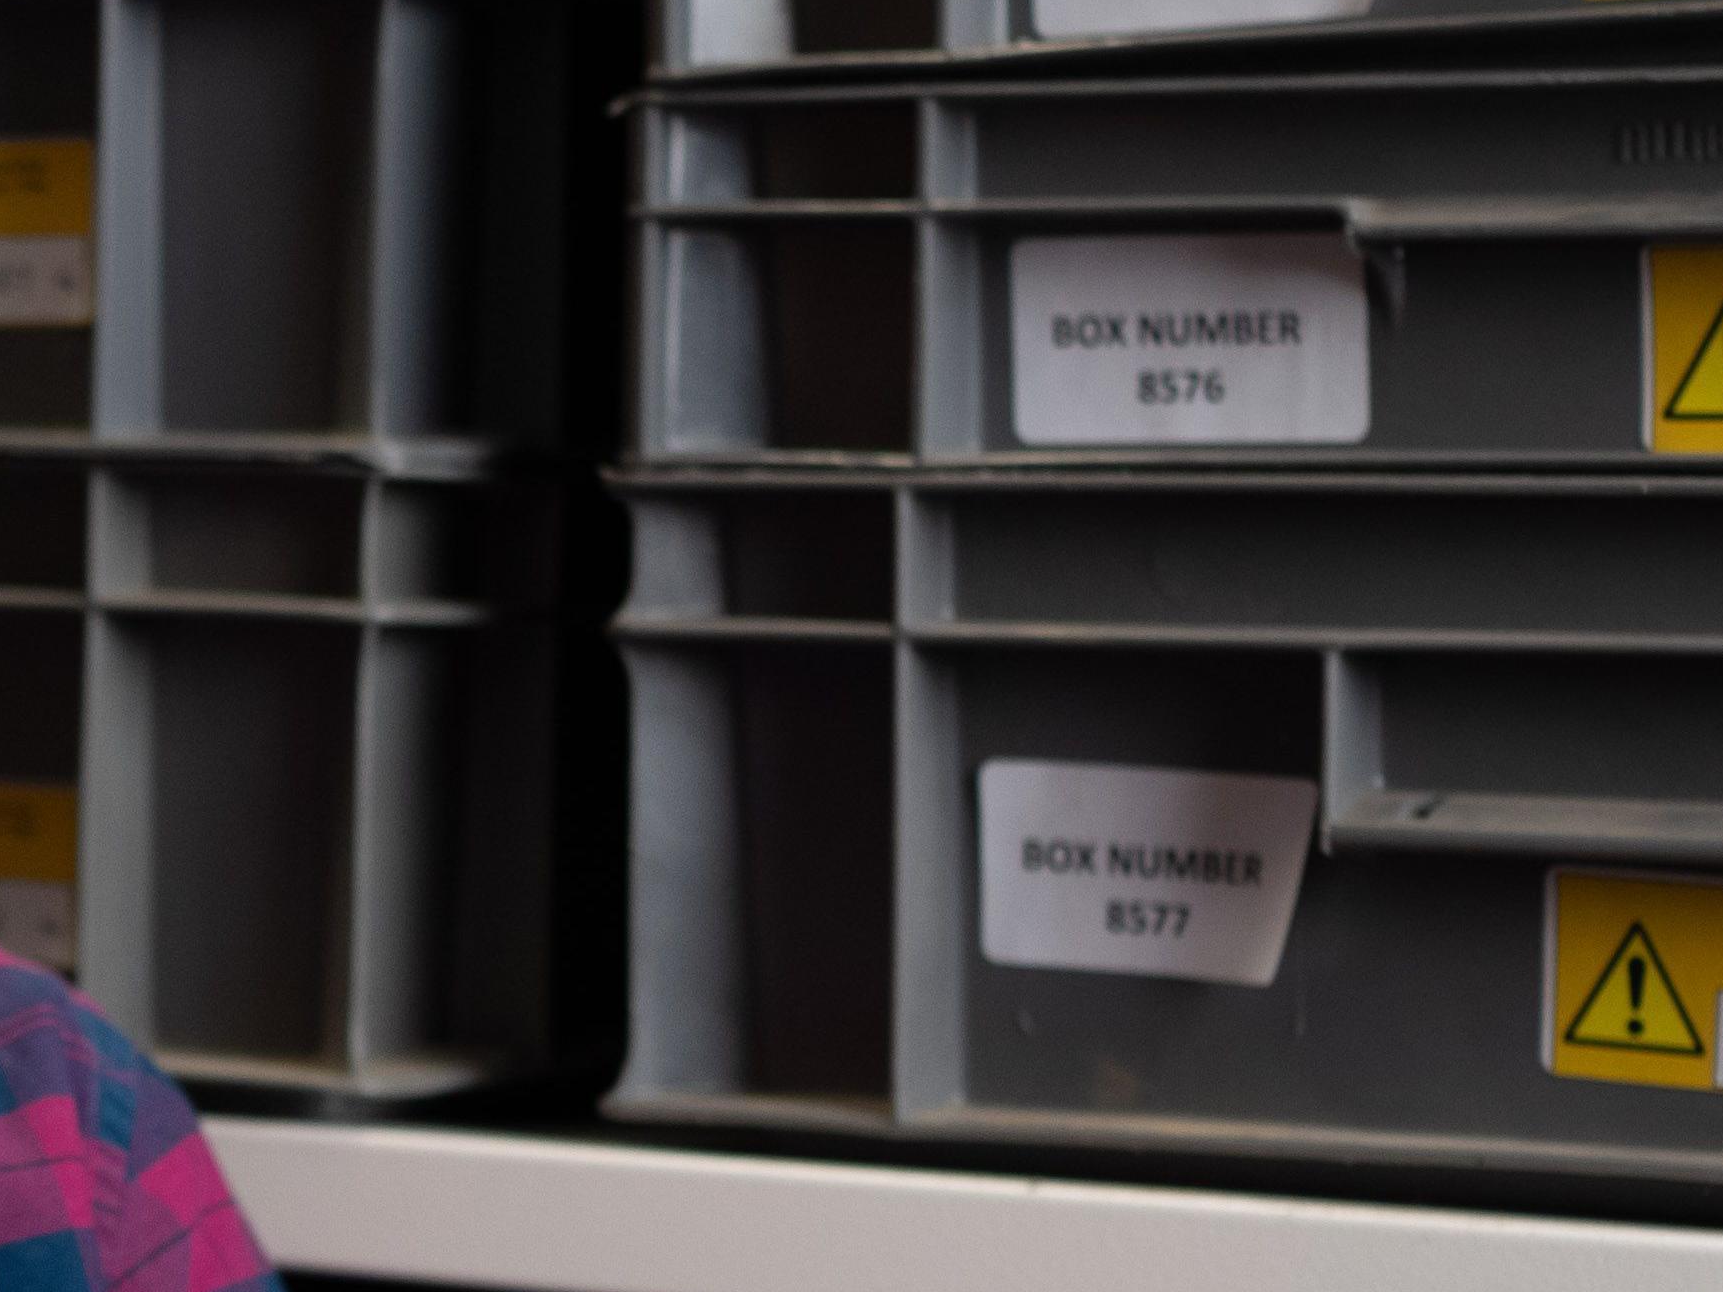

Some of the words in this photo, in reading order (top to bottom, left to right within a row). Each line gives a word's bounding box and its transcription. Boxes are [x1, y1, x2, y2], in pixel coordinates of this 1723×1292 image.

[1052, 314, 1128, 348] BOX
[1138, 311, 1301, 346] NUMBER
[1137, 368, 1225, 405] 8576
[1021, 838, 1097, 875] BOX
[1107, 844, 1263, 886] NUMBER
[1105, 900, 1190, 938] 8577
